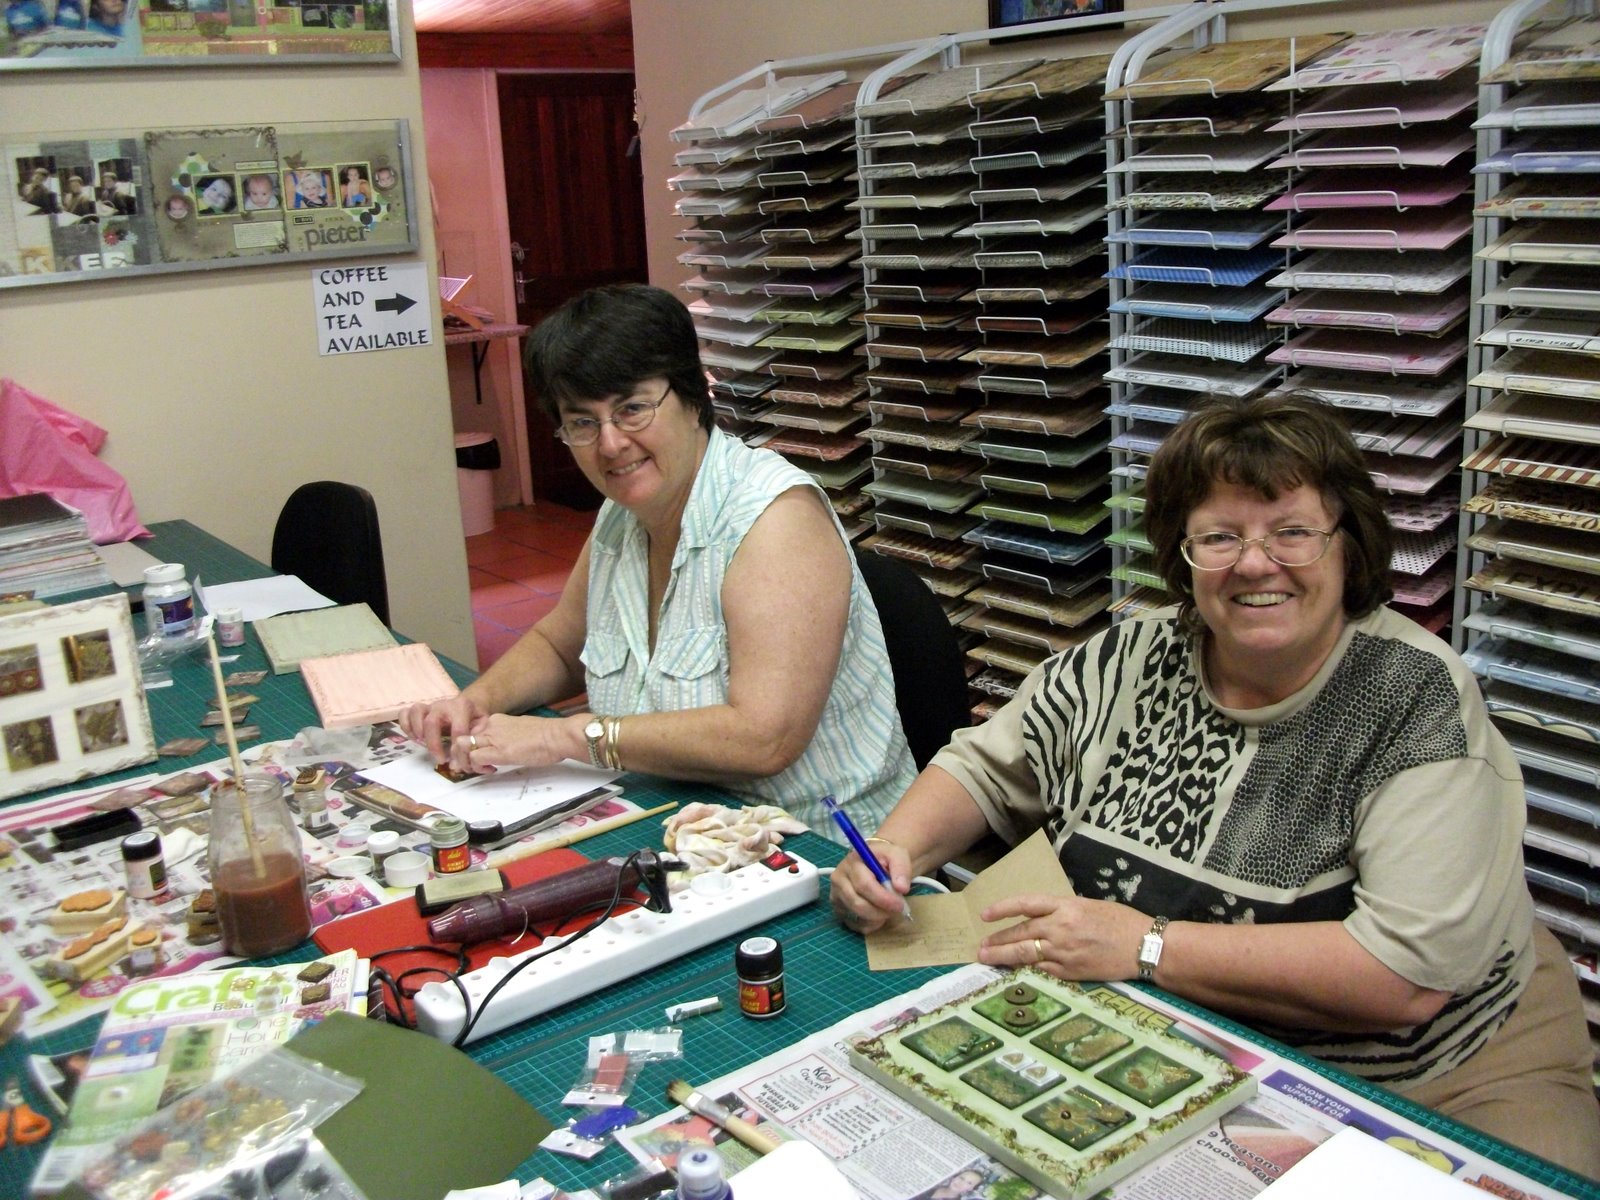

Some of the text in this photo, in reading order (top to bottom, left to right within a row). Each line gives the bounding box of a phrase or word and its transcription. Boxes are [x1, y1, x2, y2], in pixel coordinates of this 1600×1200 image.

[305, 224, 368, 248] pieter
[320, 266, 388, 285] COFFEE
[322, 291, 365, 308] AND
[323, 313, 362, 330] TEA
[327, 329, 429, 353] AVAILABLE
[785, 1098, 800, 1112] YOU
[1281, 1083, 1345, 1119] SUPPORT FOR
[1295, 1082, 1352, 1114] SHOW YOUR
[1196, 1139, 1247, 1167] choose
[1207, 1130, 1282, 1173] 9 Reasons
